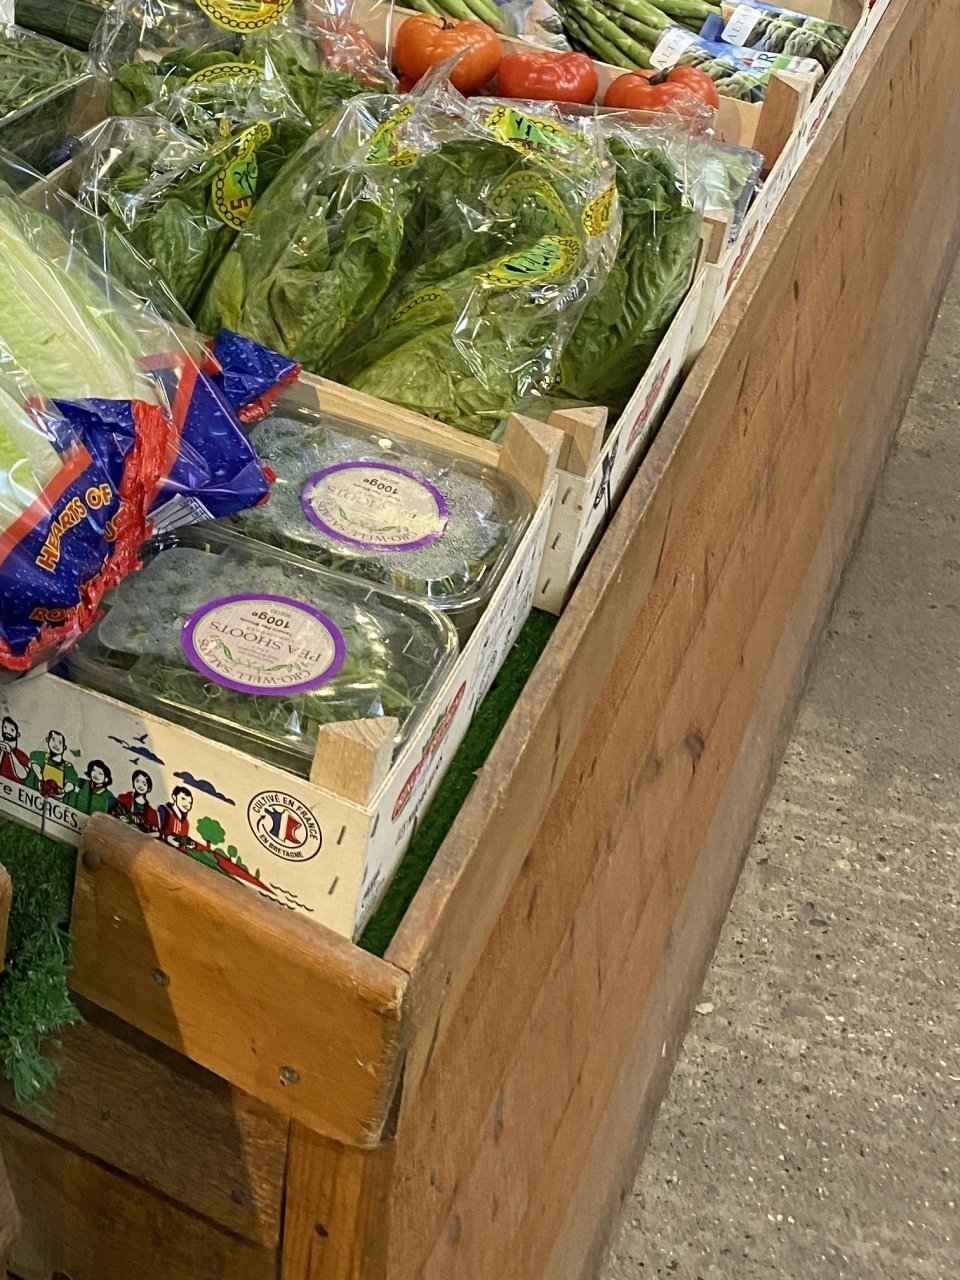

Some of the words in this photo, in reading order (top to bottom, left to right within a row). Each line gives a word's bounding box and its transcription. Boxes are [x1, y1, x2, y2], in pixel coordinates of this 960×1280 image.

[35, 497, 88, 574] HEARTS
[85, 483, 113, 510] OF
[209, 621, 284, 650] SHOOTS
[287, 645, 322, 663] PEA
[239, 669, 311, 685] GRO-WELL
[252, 793, 281, 814] CULTIVÉ
[282, 797, 295, 808] EN
[296, 805, 319, 841] FRANCE
[259, 834, 270, 844] EN
